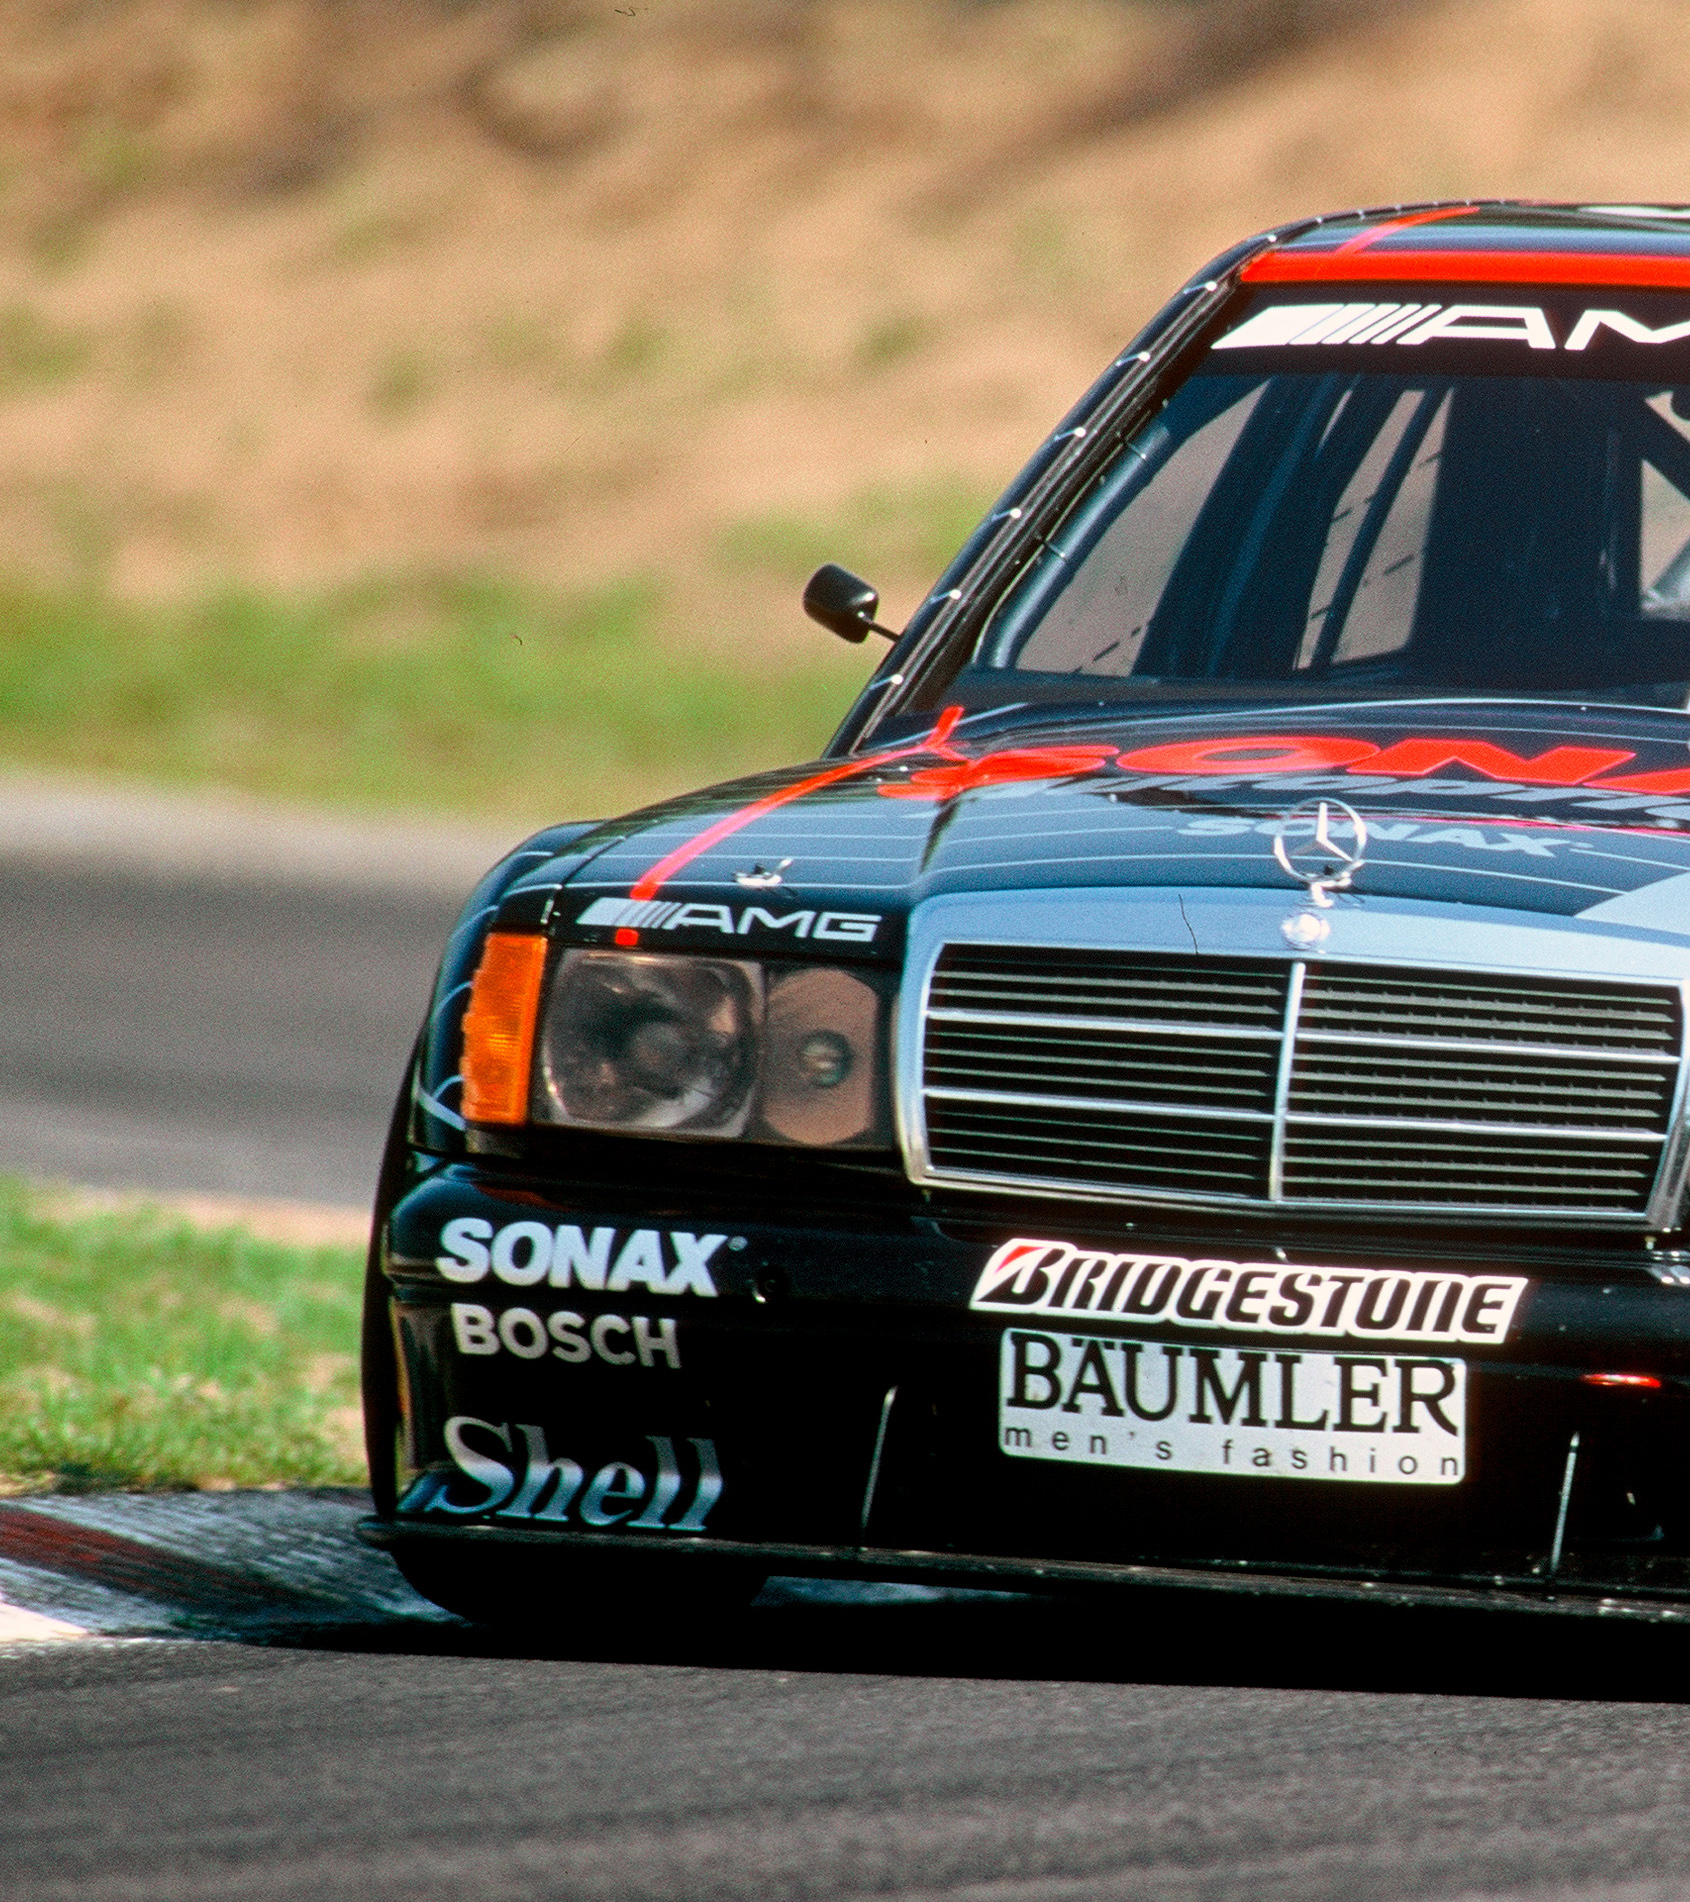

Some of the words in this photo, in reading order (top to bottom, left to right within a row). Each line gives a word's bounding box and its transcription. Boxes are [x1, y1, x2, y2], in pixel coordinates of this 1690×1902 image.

[1177, 816, 1571, 858] SONAX
[660, 904, 882, 943] AMG
[436, 1218, 728, 1297] SONAX
[977, 1243, 1513, 1336] BRIDGESTONE
[451, 1303, 682, 1369] BOSCH
[1006, 1331, 1459, 1436] BÄUMLER
[436, 1416, 724, 1531] Shell
[1004, 1424, 1172, 1461] men's
[1222, 1438, 1460, 1478] fashion
